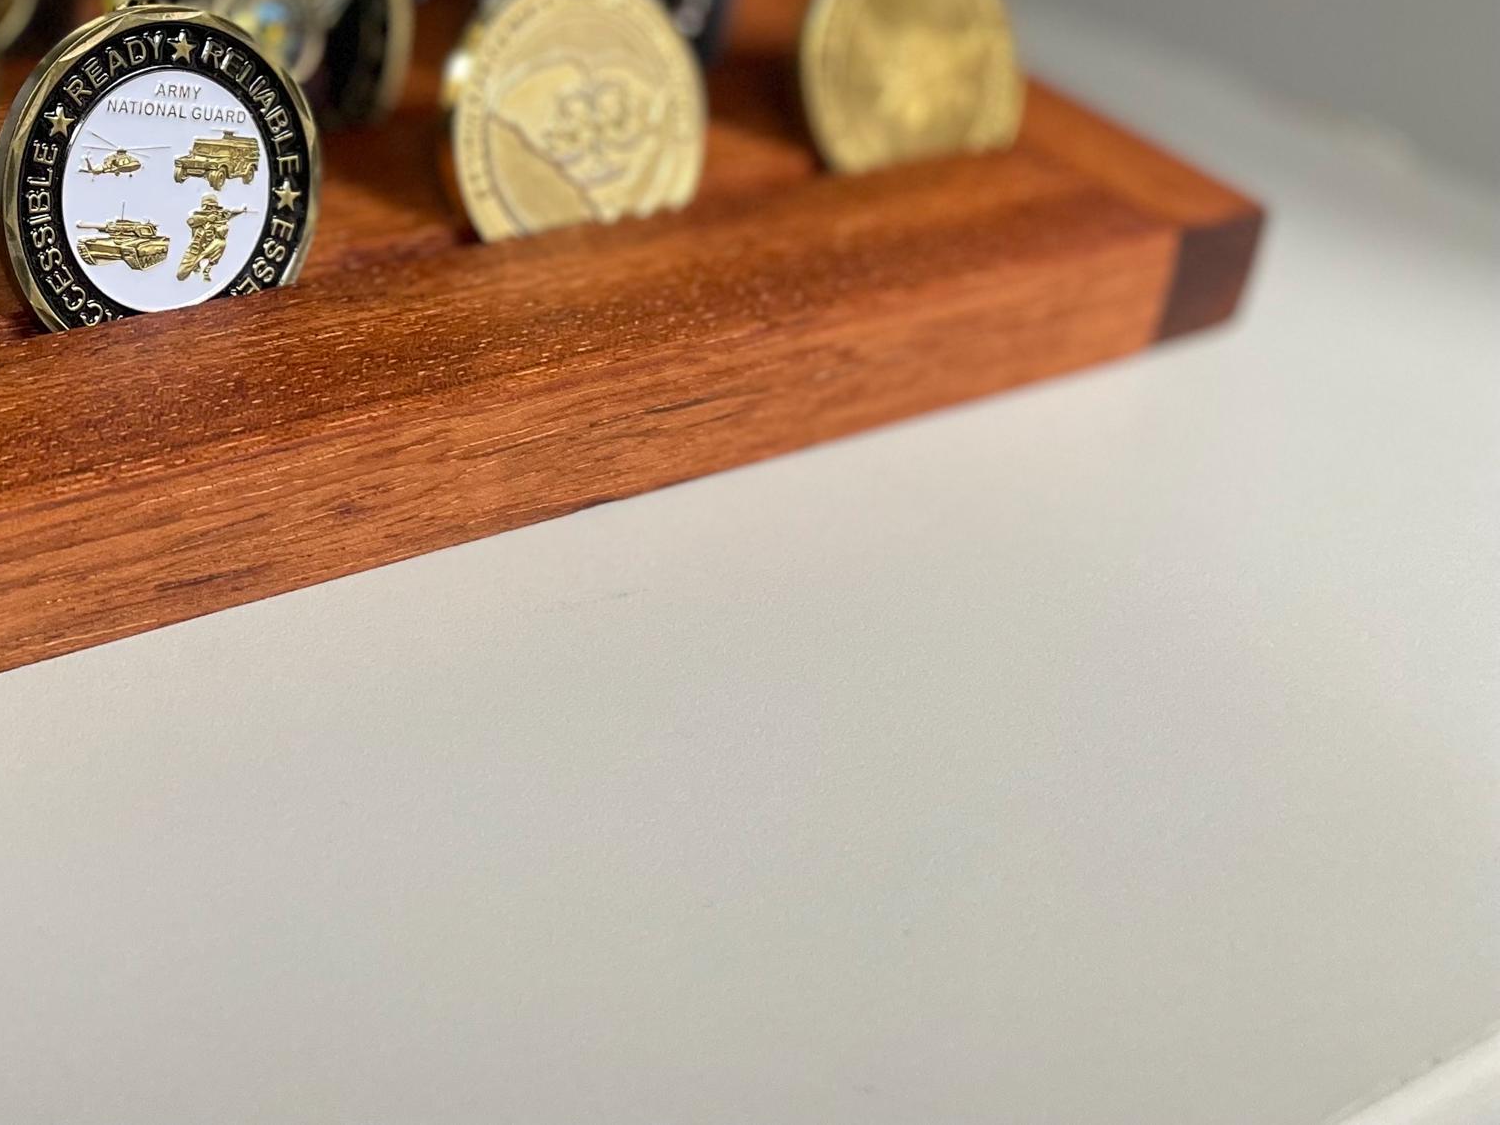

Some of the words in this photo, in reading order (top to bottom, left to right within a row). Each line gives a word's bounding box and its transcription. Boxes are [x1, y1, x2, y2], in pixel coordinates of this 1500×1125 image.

[63, 30, 164, 107] READY
[155, 82, 202, 100] ARMY
[202, 36, 300, 175] RELIABLE
[106, 99, 187, 119] NATIONAL
[191, 105, 247, 124] GUARD
[28, 139, 122, 326] CCESSIBLE
[231, 217, 295, 295] ESSE
